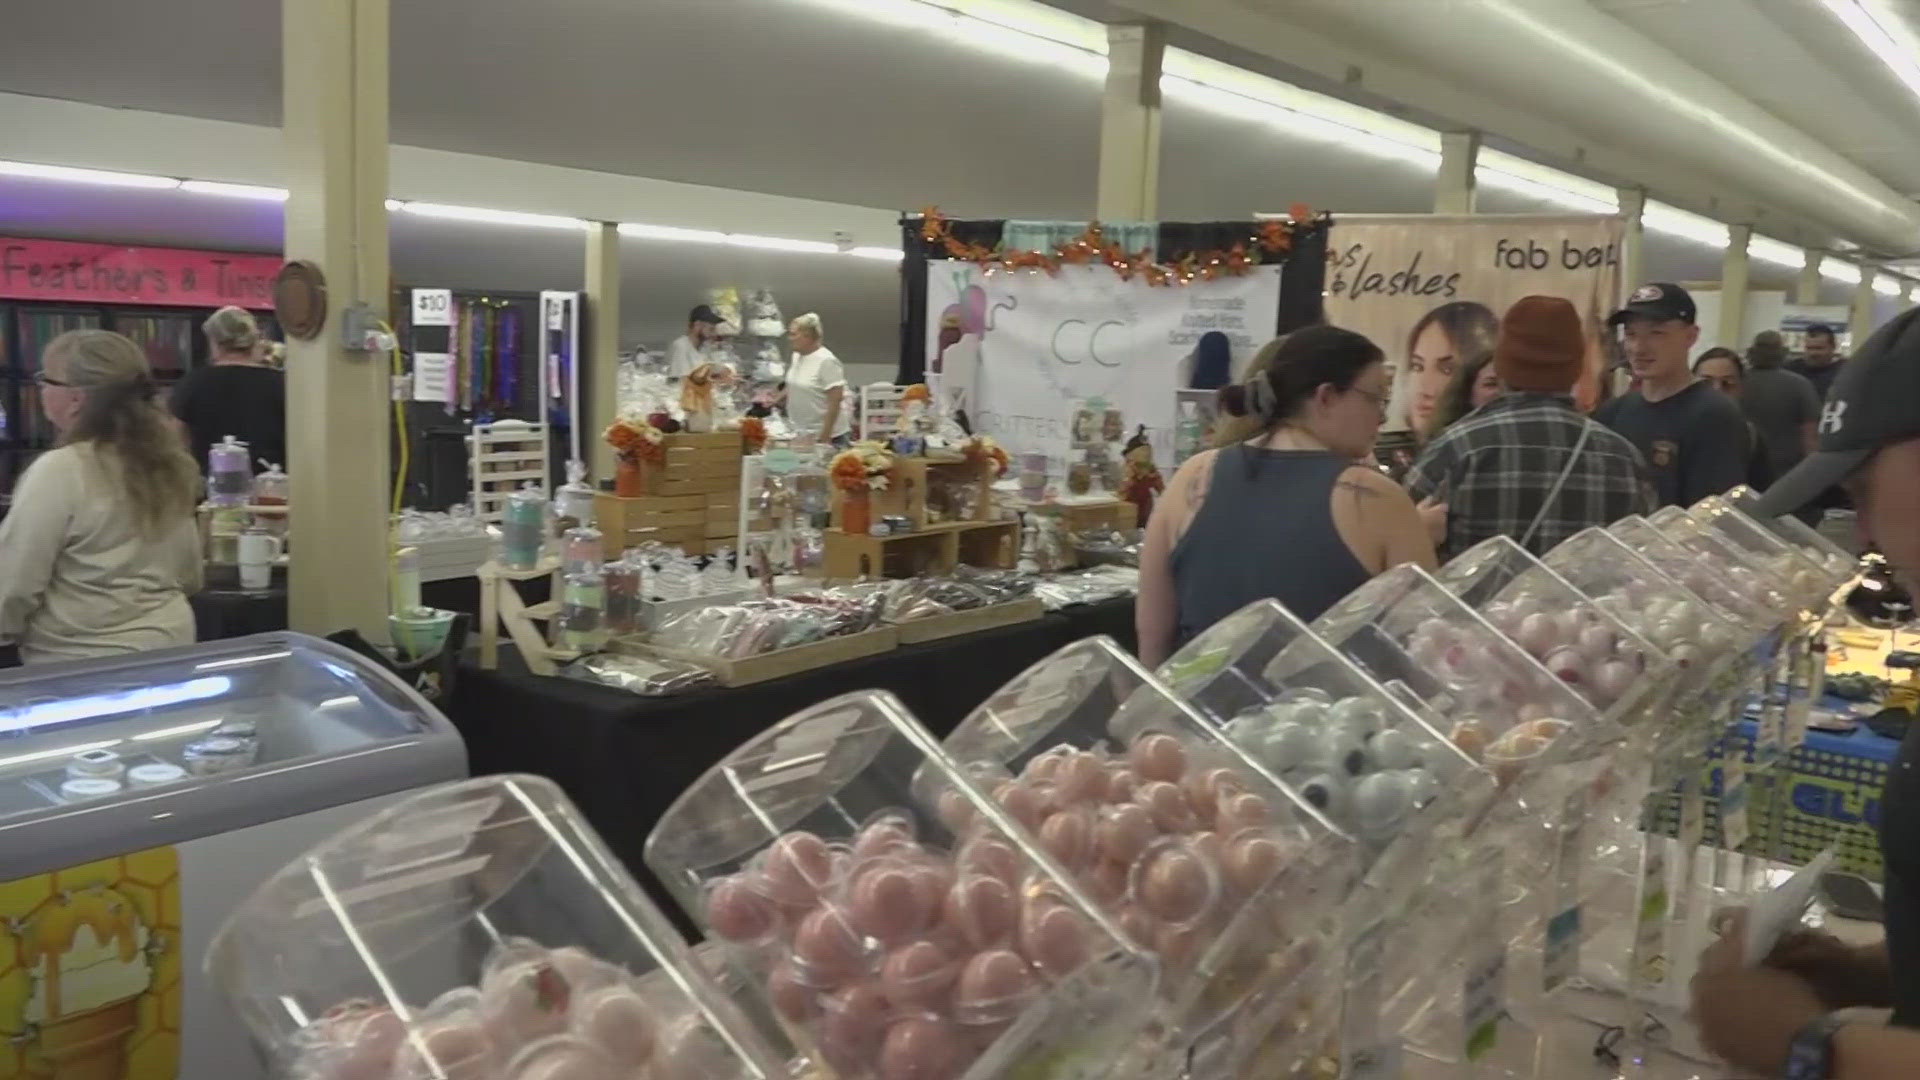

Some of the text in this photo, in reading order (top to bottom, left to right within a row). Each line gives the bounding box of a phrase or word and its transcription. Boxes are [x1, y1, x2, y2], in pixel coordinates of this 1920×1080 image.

[3, 245, 169, 294] Feathers
[210, 259, 278, 299] Tins
[1350, 250, 1461, 300] lashes
[1494, 239, 1548, 269] fab
[1051, 319, 1126, 367] CC
